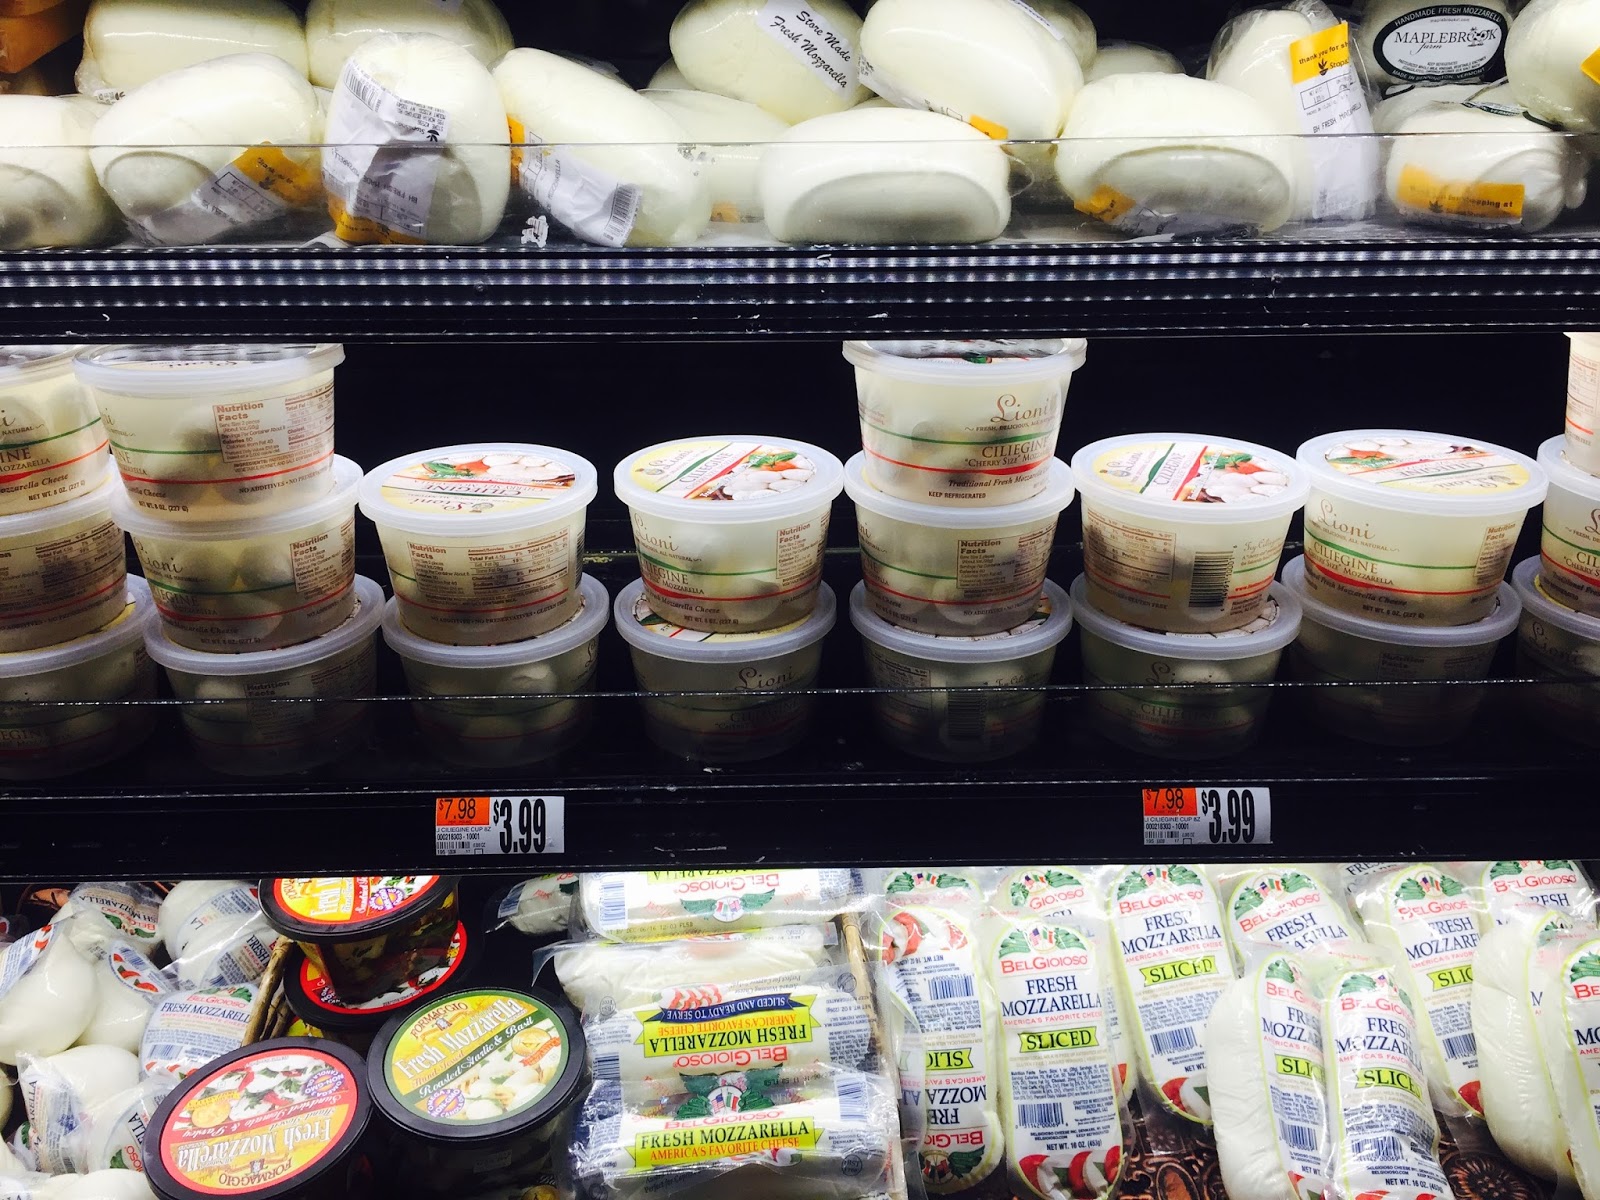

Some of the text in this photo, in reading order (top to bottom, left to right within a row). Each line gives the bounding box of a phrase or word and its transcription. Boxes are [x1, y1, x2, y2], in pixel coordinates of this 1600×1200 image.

[1394, 7, 1501, 27] HANDMADE FRESH MOZZARELL
[796, 10, 850, 61] Store Made
[1394, 27, 1498, 44] MAPLEBROOK
[770, 16, 847, 88] Fresh Mozzarella
[1299, 53, 1318, 65] thank
[1318, 49, 1328, 60] you
[1329, 45, 1339, 53] for
[1409, 42, 1443, 55] farm
[1392, 70, 1408, 78] MADE
[1321, 116, 1337, 129] FRESH
[384, 184, 406, 200] FRESH
[216, 402, 264, 413] Nutrition
[218, 413, 248, 421] Facts
[990, 393, 1050, 423] Lioni
[2, 425, 34, 436] NATURAL
[975, 424, 999, 432] FRESH,
[982, 436, 1050, 458] CILIEGINE
[680, 452, 733, 483] CILIEGINE
[42, 473, 69, 485] Cheese
[250, 481, 285, 492] ADDITIVES
[948, 479, 991, 487] Traditional
[993, 478, 1013, 486] Fresh
[29, 493, 40, 501] NET
[142, 488, 166, 498] Cheese
[1317, 498, 1376, 540] Lioni
[1487, 522, 1516, 535] Nutrition
[634, 512, 679, 552] Lioni
[779, 523, 811, 537] Nutrition
[779, 534, 800, 544] Facts
[1485, 532, 1505, 541] Facts
[291, 533, 328, 550] Nutrition
[293, 545, 317, 557] Facts
[409, 543, 447, 554] Nutrition
[960, 539, 1001, 547] Nutrition
[1360, 540, 1389, 551] NATURAL
[411, 551, 433, 560] Facts
[1313, 541, 1378, 574] CILIEGINE
[1343, 567, 1394, 586] MOZZARELLA
[662, 581, 704, 595] MOZZARELLA
[1320, 574, 1408, 606] Fresh Mozzarella Cheese
[486, 611, 533, 623] PRESERVATIVES
[536, 602, 557, 615] GLUTEN
[662, 597, 720, 614] Mozzarella Cheese
[1151, 602, 1168, 610] FREE
[1362, 604, 1373, 612] NET
[734, 665, 795, 691] Lioni
[439, 798, 546, 853] $7.98 $3.99
[1146, 788, 1255, 843] $7.98 $3.99
[1144, 909, 1193, 932] FRESH
[1265, 912, 1317, 941] FRESH
[1429, 917, 1474, 937] FRESH
[246, 934, 270, 964] FRESH
[1121, 924, 1222, 955] MOZZARELLA
[1150, 958, 1213, 983] SLICED
[1026, 975, 1078, 995] FRESH
[160, 1002, 251, 1023] FRESH MOZZARELL
[666, 996, 786, 1020] SLICED AND READY TO SERVE
[1001, 992, 1102, 1017] MOZZARELLA
[410, 1001, 469, 1039] FORMAGGIO
[658, 1015, 797, 1036] AMERICA'S FAVORITE CHEESE
[1003, 1017, 1043, 1026] AMERICA'S
[1045, 1013, 1075, 1023] FAVORITE
[394, 997, 524, 1079] Fresh Mozzarella
[648, 1024, 807, 1053] FRESH MOZZARELLA
[1026, 1029, 1092, 1051] SLICED
[419, 1065, 464, 1099] Roasted
[494, 1037, 503, 1046] &
[505, 1016, 534, 1038] Basil
[305, 1073, 344, 1094] NON-GMO
[283, 1119, 332, 1150] Fresh
[641, 1120, 810, 1150] FRESH MOZZARELLA
[177, 1132, 277, 1173] Mozzarella
[650, 1137, 800, 1161] AMERICA'S FAVORITE CHEESE
[1046, 1143, 1057, 1151] NET
[1060, 1142, 1069, 1150] WT.
[218, 1157, 292, 1187] FORMAGGIO
[1301, 1166, 1311, 1174] NET
